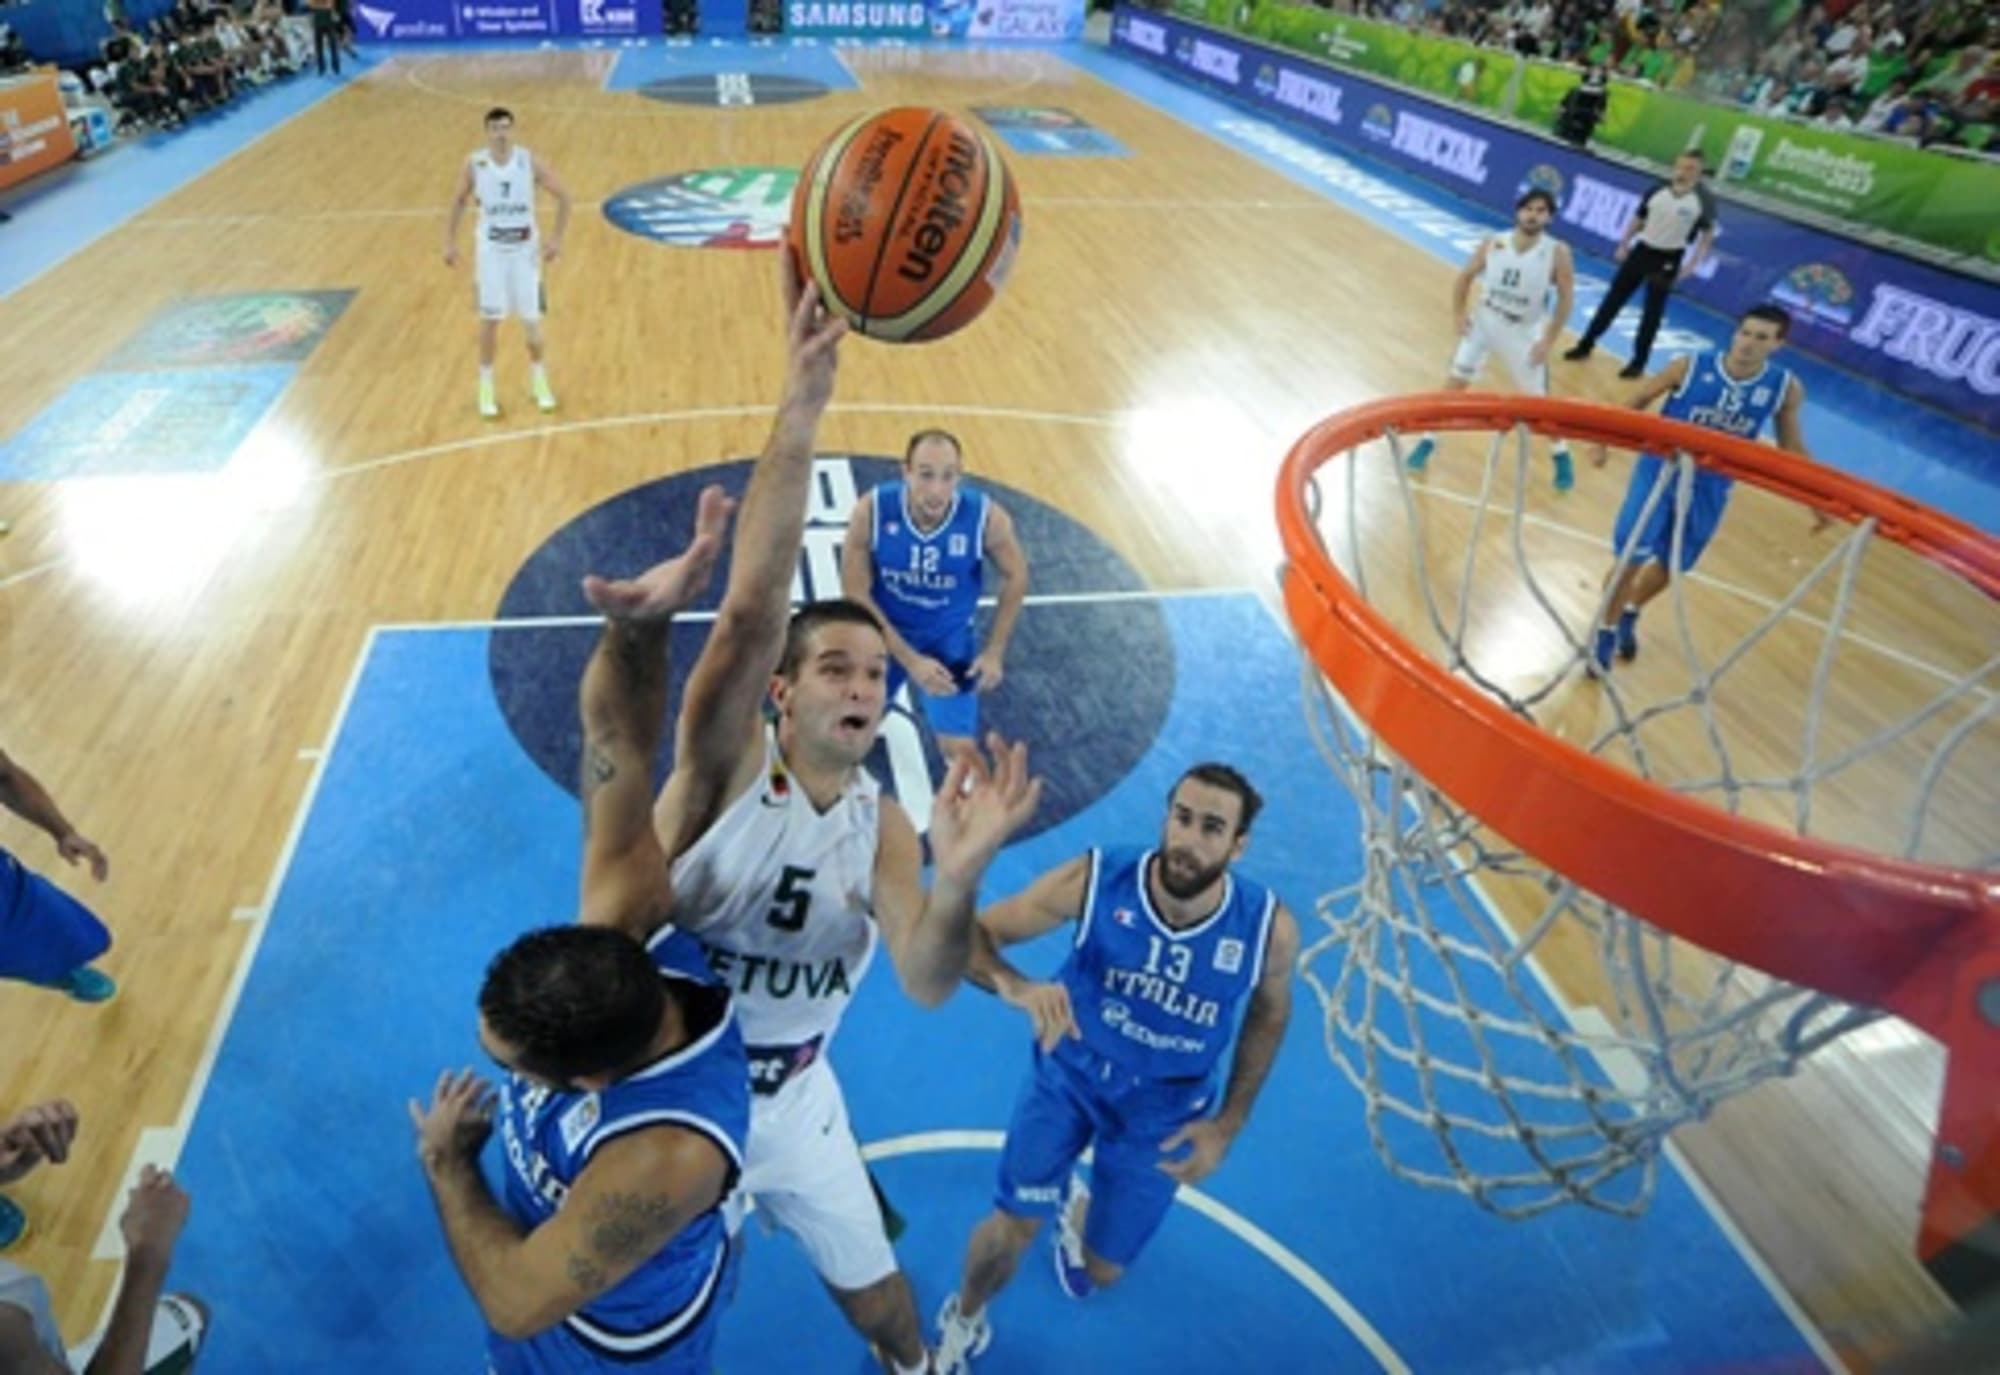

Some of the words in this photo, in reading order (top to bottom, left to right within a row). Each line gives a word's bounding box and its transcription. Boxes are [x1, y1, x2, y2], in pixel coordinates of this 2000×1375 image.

[788, 3, 925, 28] SAMSUNG
[1391, 111, 1489, 184] FRUCTAL
[898, 131, 976, 282] molten
[910, 544, 940, 572] 12
[766, 864, 817, 932] 5
[703, 946, 850, 999] ETUVA
[1142, 935, 1193, 984] 13
[1103, 967, 1220, 1028] ITALIA
